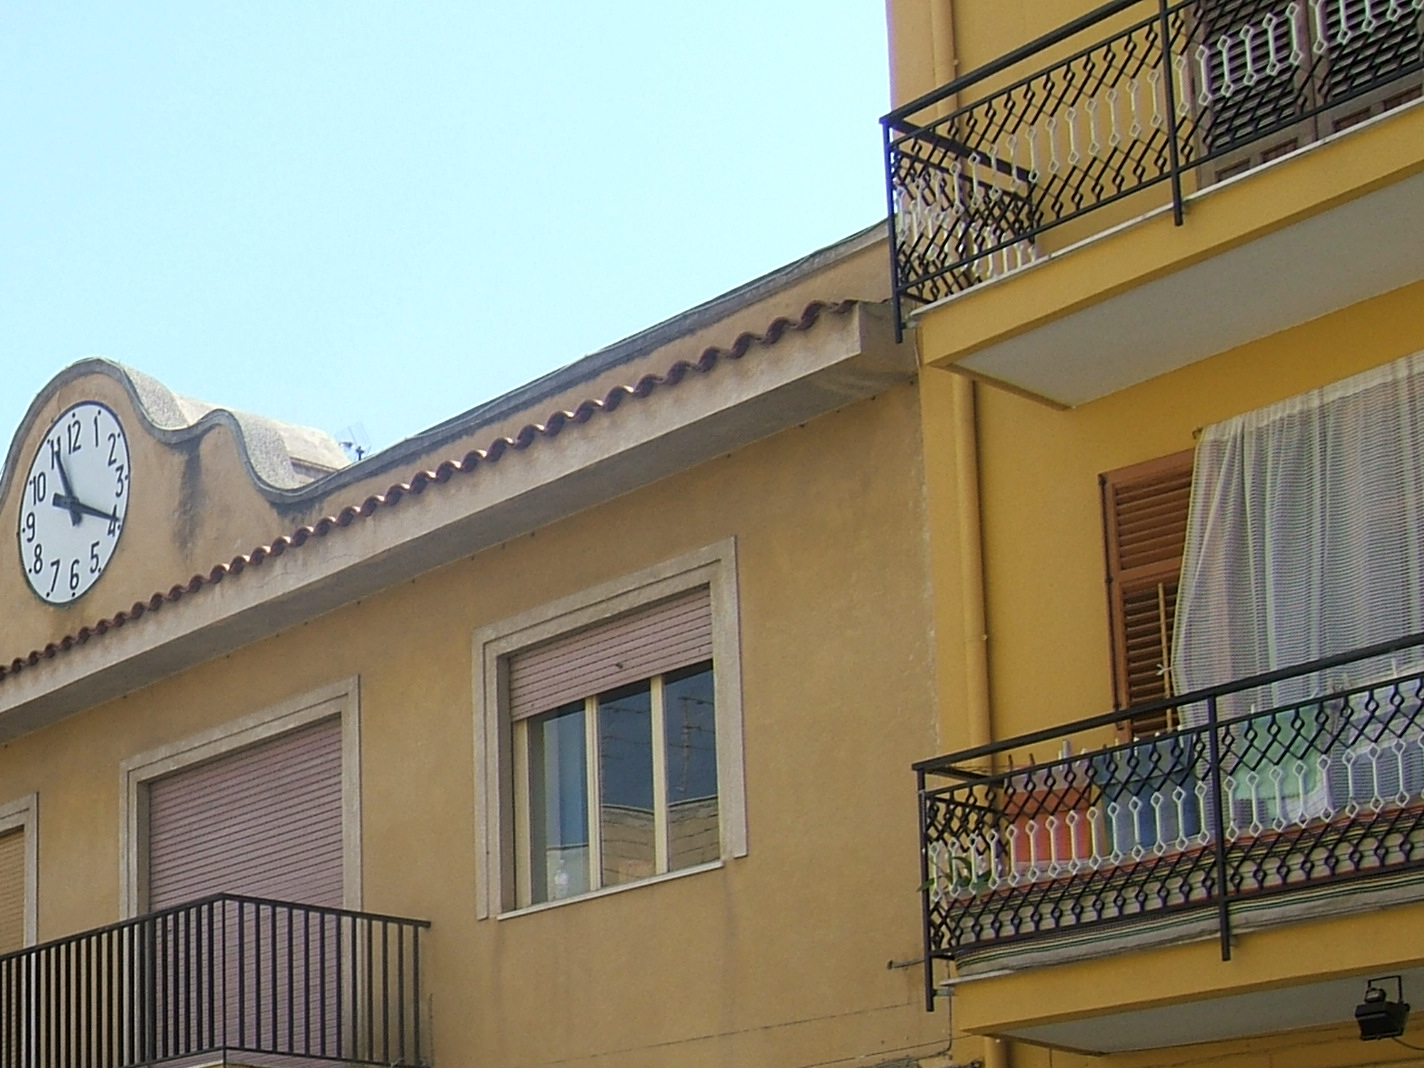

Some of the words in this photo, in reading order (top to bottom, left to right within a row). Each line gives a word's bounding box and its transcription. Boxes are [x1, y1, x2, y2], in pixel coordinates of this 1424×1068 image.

[67, 420, 82, 455] 12
[93, 415, 100, 447] 1
[107, 433, 117, 467] 2
[32, 471, 47, 506] 10
[115, 464, 124, 498] 3
[26, 512, 36, 543] 9
[107, 504, 120, 537] 4
[33, 544, 43, 574] 8
[89, 541, 100, 574] 5
[50, 559, 61, 593] 7
[69, 559, 80, 591] 6
